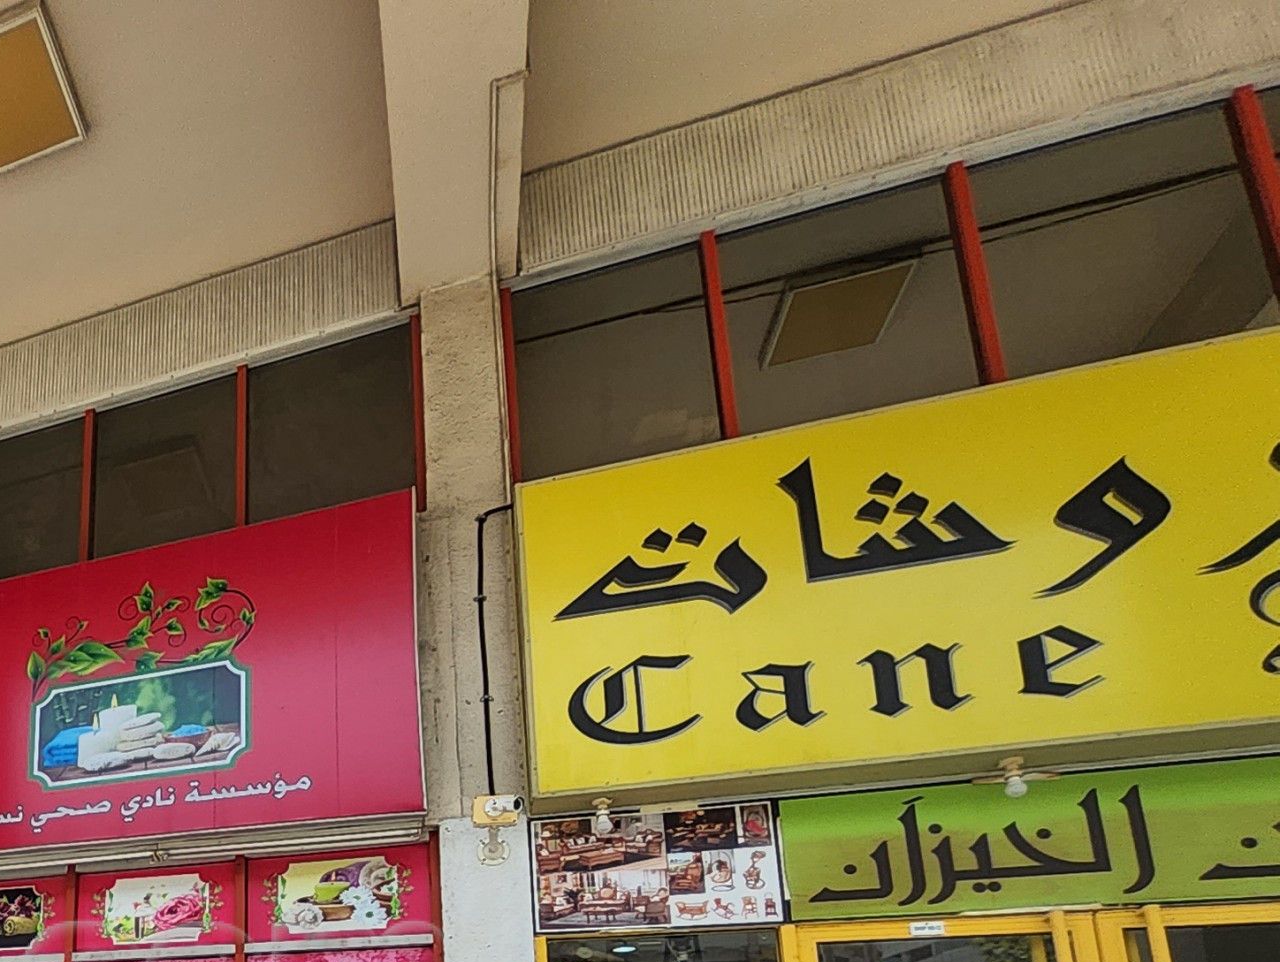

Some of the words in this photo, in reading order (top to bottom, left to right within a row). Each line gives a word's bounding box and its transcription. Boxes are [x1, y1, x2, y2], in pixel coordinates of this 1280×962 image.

[568, 624, 1106, 745] Cane
[120, 785, 176, 823] نادي
[184, 772, 312, 802] مؤسسة
[30, 799, 113, 833] صحي
